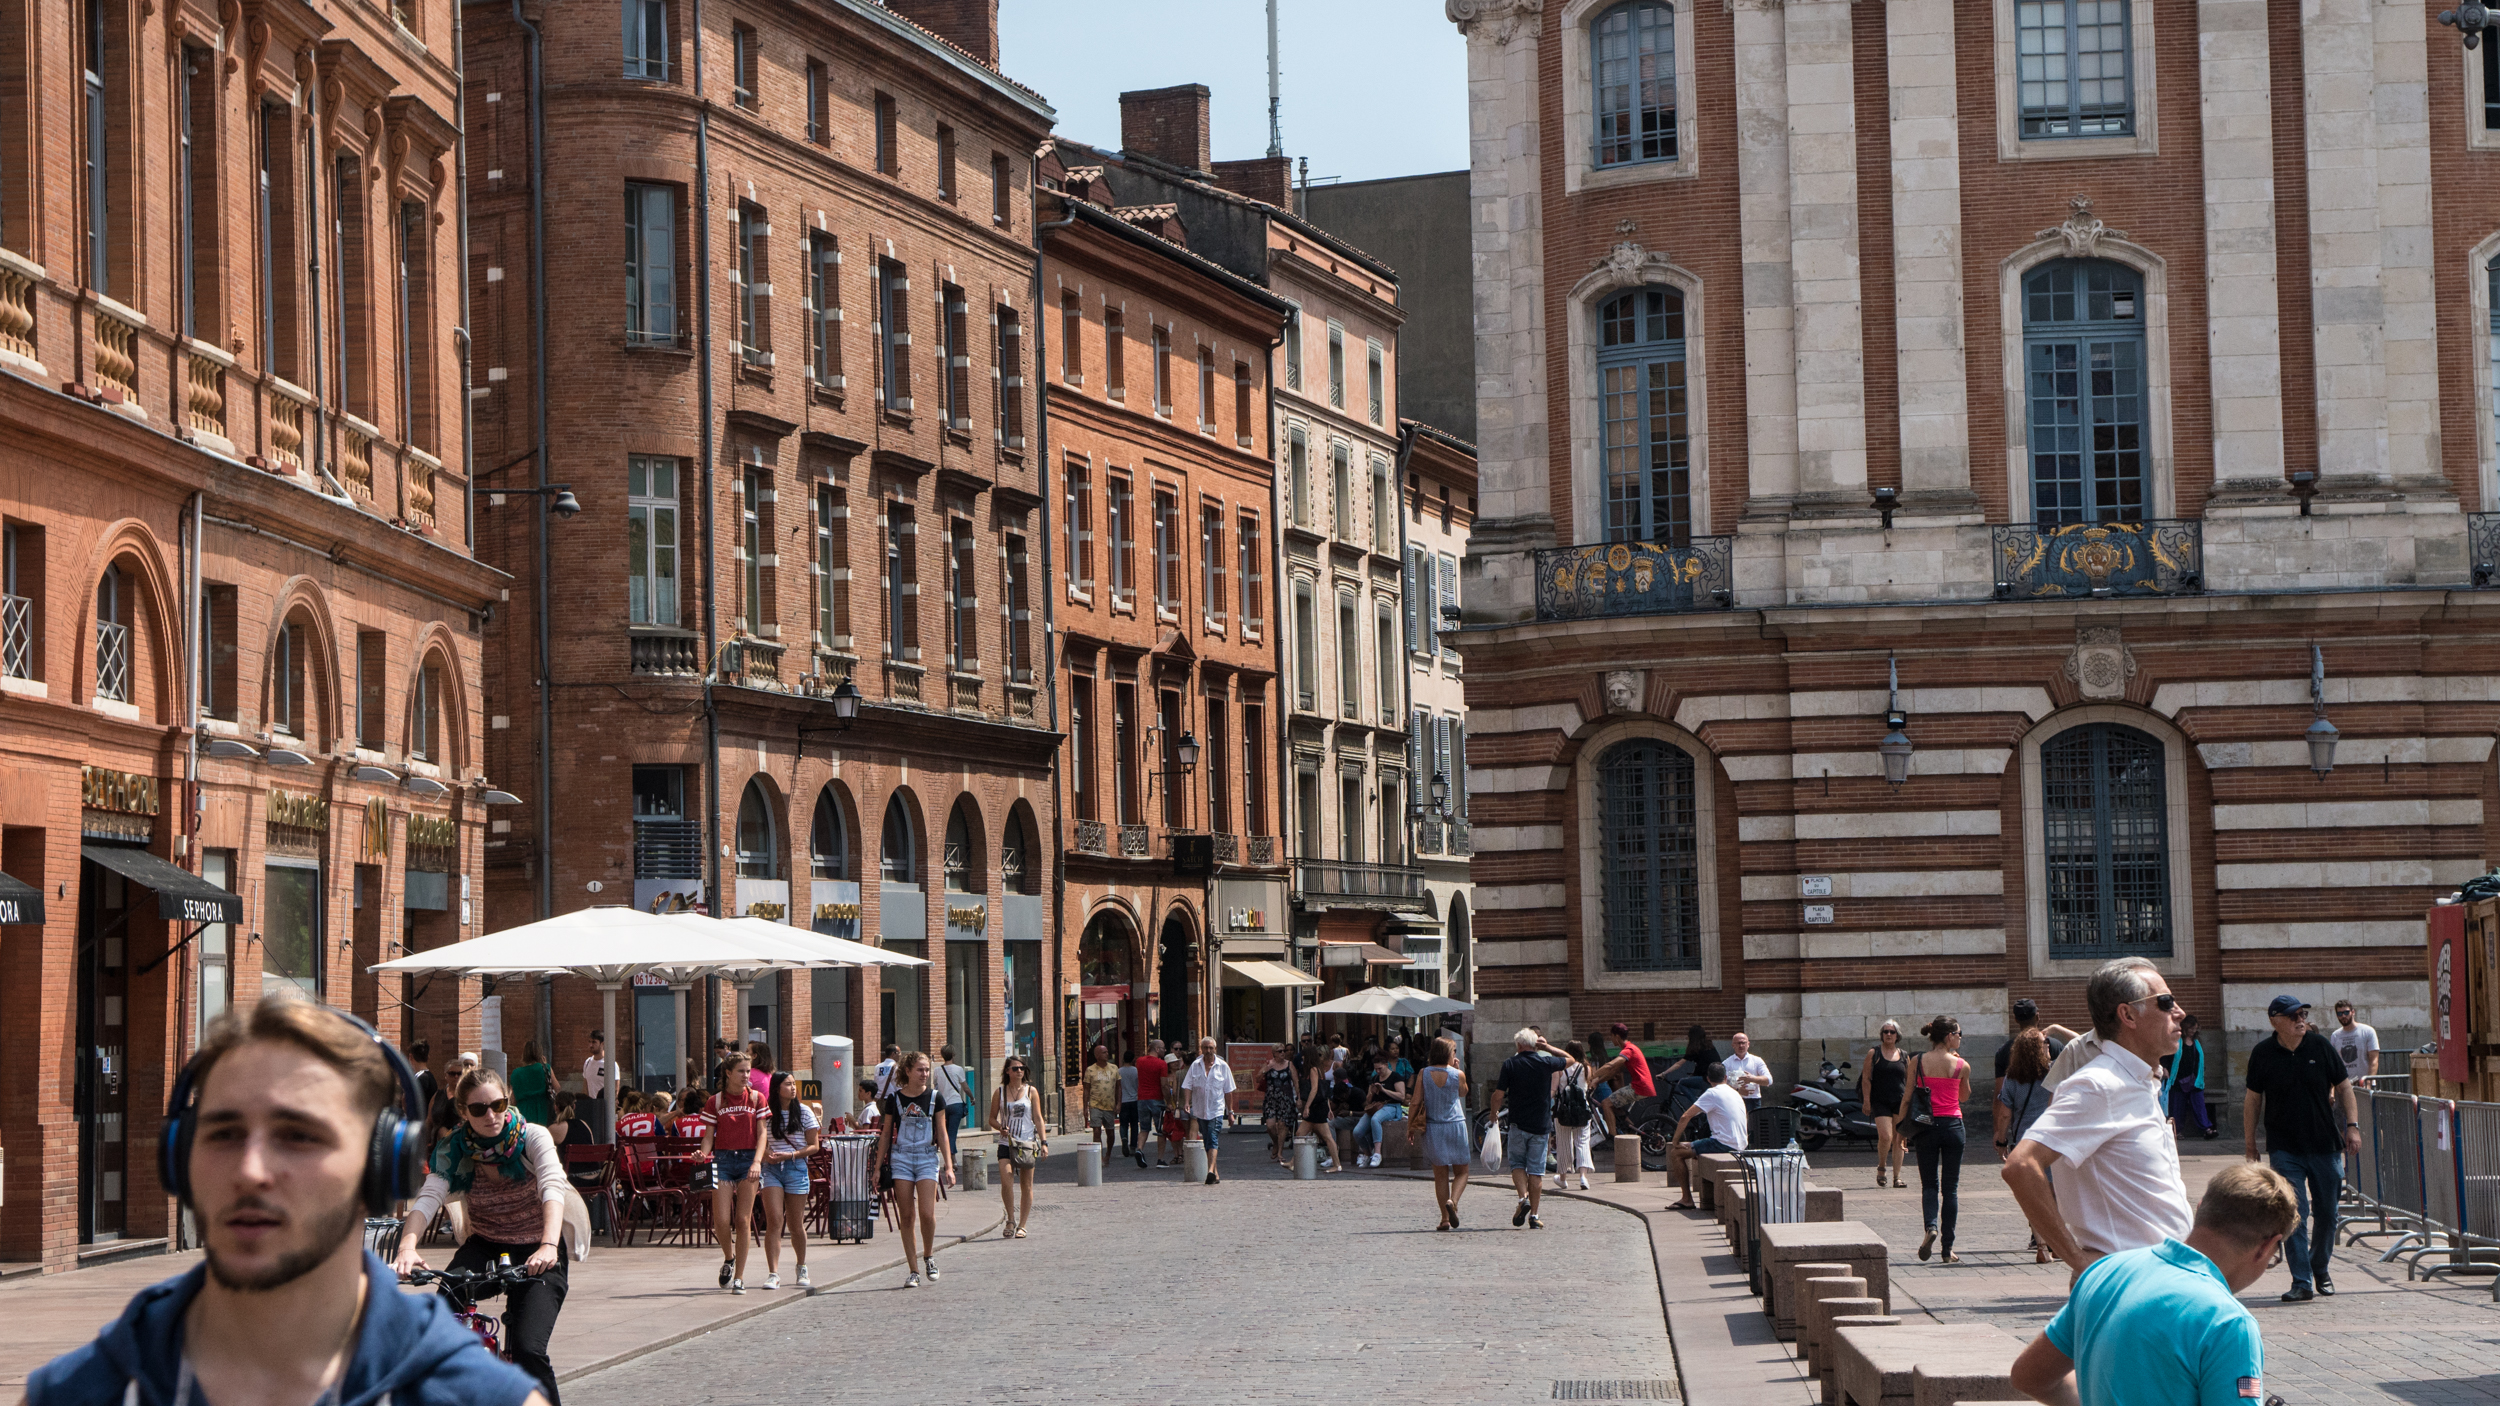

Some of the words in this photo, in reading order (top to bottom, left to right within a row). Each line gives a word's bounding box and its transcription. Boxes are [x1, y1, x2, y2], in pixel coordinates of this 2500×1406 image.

[81, 765, 160, 814] SEPHORA
[183, 898, 224, 921] SEPHORA
[635, 974, 644, 985] 06
[645, 974, 653, 985] 12
[717, 1105, 757, 1116] BEACHVILLE
[620, 1113, 648, 1125] LOULOU
